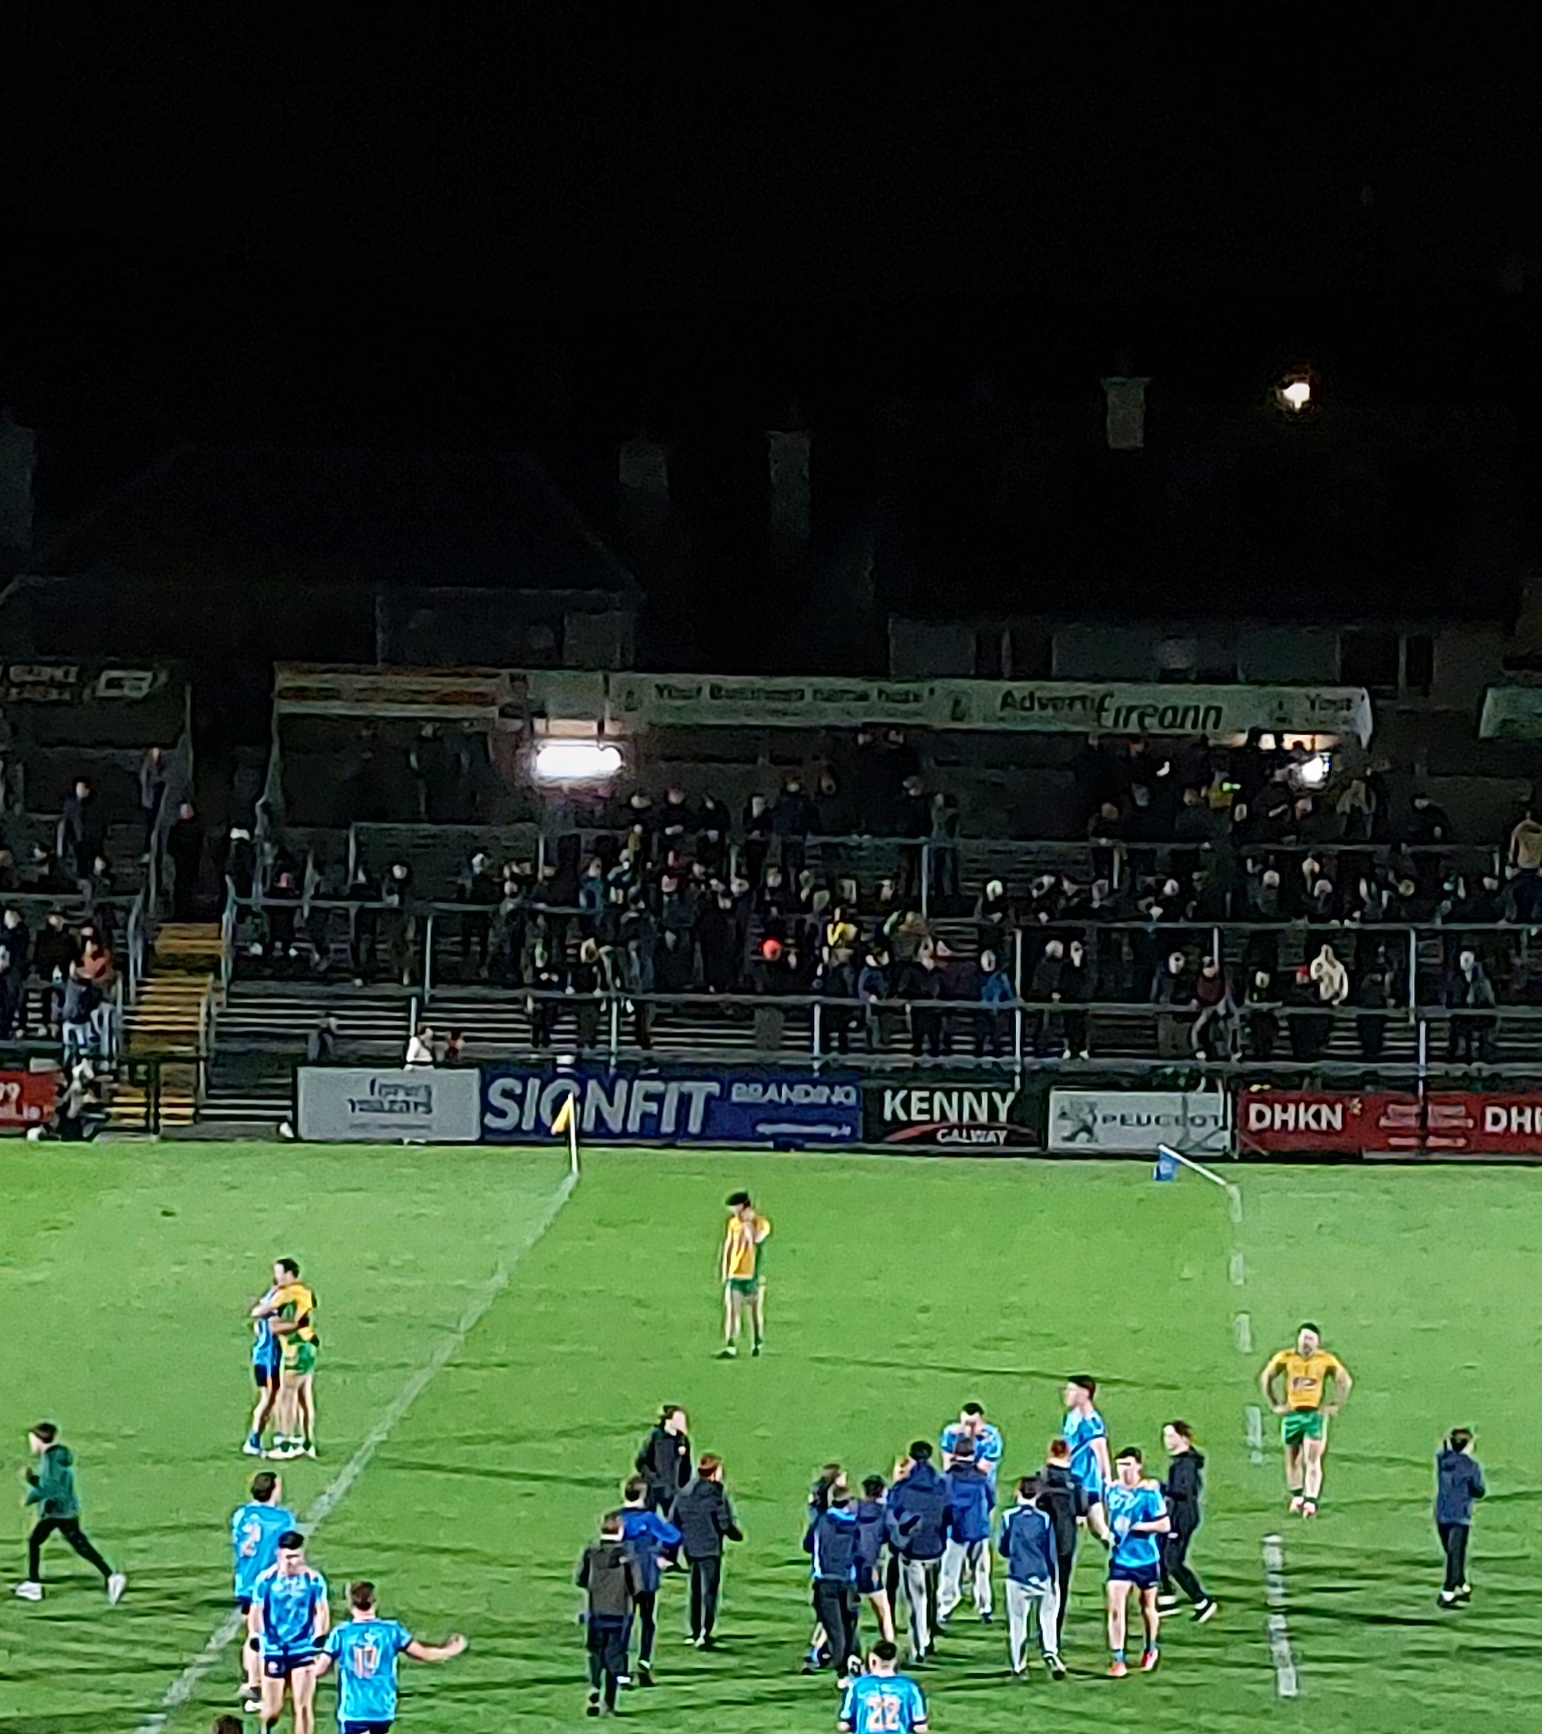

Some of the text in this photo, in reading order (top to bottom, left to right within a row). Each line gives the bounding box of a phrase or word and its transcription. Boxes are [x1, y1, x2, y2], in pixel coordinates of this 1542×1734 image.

[483, 1076, 719, 1134] SIGNFIT
[730, 1082, 857, 1106] BRANDING
[883, 1088, 1016, 1124] KENNY
[1247, 1102, 1343, 1132] DHKN
